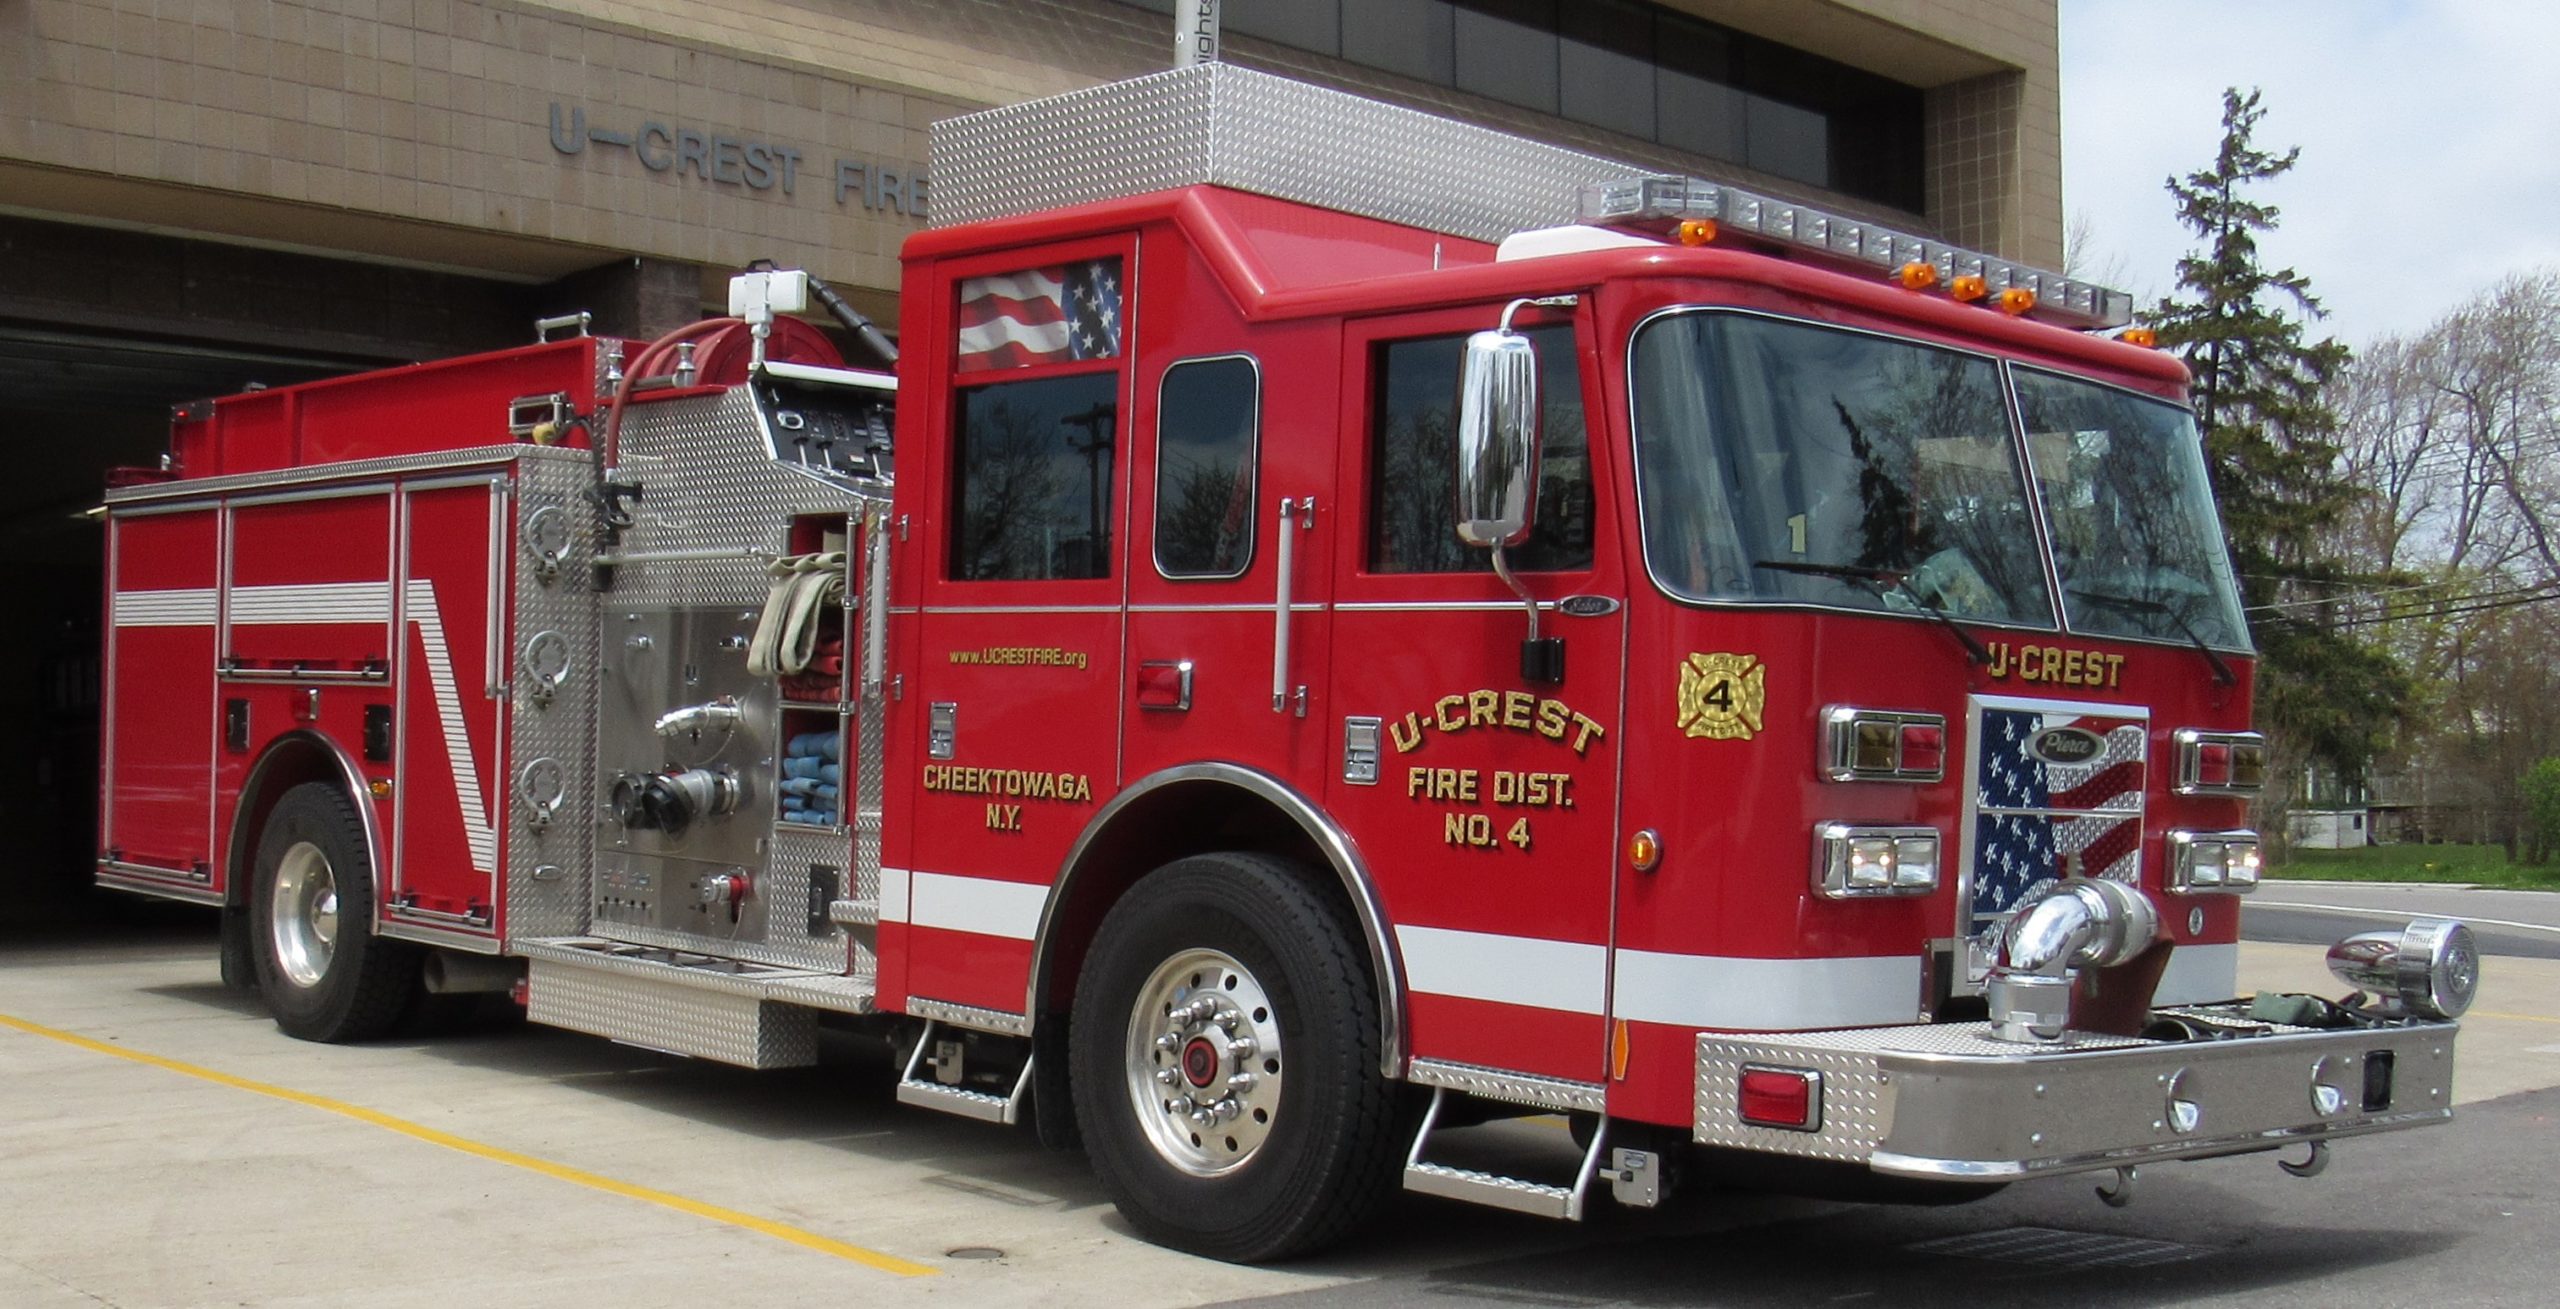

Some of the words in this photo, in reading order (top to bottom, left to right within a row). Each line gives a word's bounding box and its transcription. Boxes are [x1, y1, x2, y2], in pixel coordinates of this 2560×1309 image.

[549, 102, 800, 194] U-CREST
[835, 158, 929, 217] FIRE
[1787, 513, 1806, 554] 1
[950, 647, 1087, 669] www.UCRESTFIRE.org
[1987, 642, 2125, 688] U-CREST
[1702, 679, 1733, 713] 4
[1389, 689, 1605, 753] U-CREST
[2043, 732, 2090, 754] Pierce
[923, 764, 1091, 800] CHEEKTOWAGA
[1408, 767, 1478, 801] FIRE
[1493, 771, 1573, 806] DIST.
[985, 803, 1022, 831] N.Y.
[1444, 813, 1498, 847] NO.
[1506, 817, 1530, 849] 4
